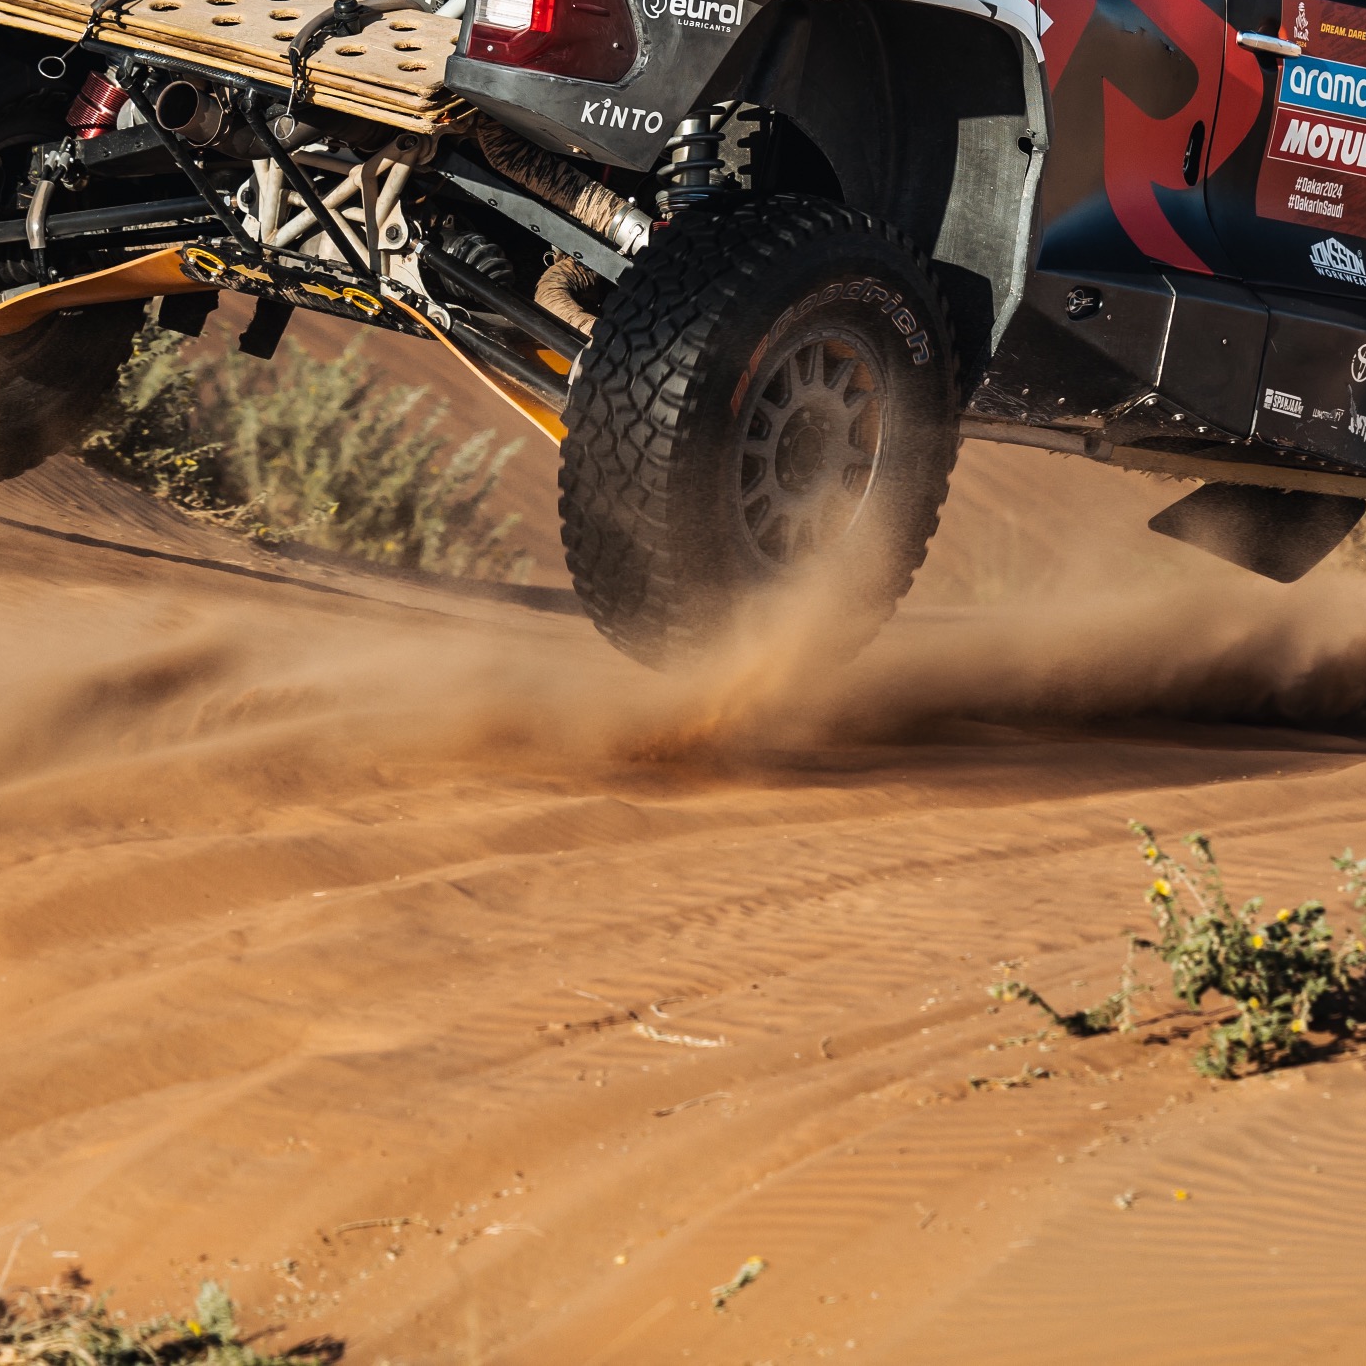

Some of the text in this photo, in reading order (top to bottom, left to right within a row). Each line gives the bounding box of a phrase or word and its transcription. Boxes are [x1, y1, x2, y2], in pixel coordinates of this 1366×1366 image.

[678, 19, 731, 33] LUBRICANTS
[1320, 22, 1347, 37] DREAM.
[1295, 176, 1343, 199] #Dakar2024
[1288, 194, 1344, 218] #DakarInSaudi
[1309, 237, 1366, 275] JONSSON
